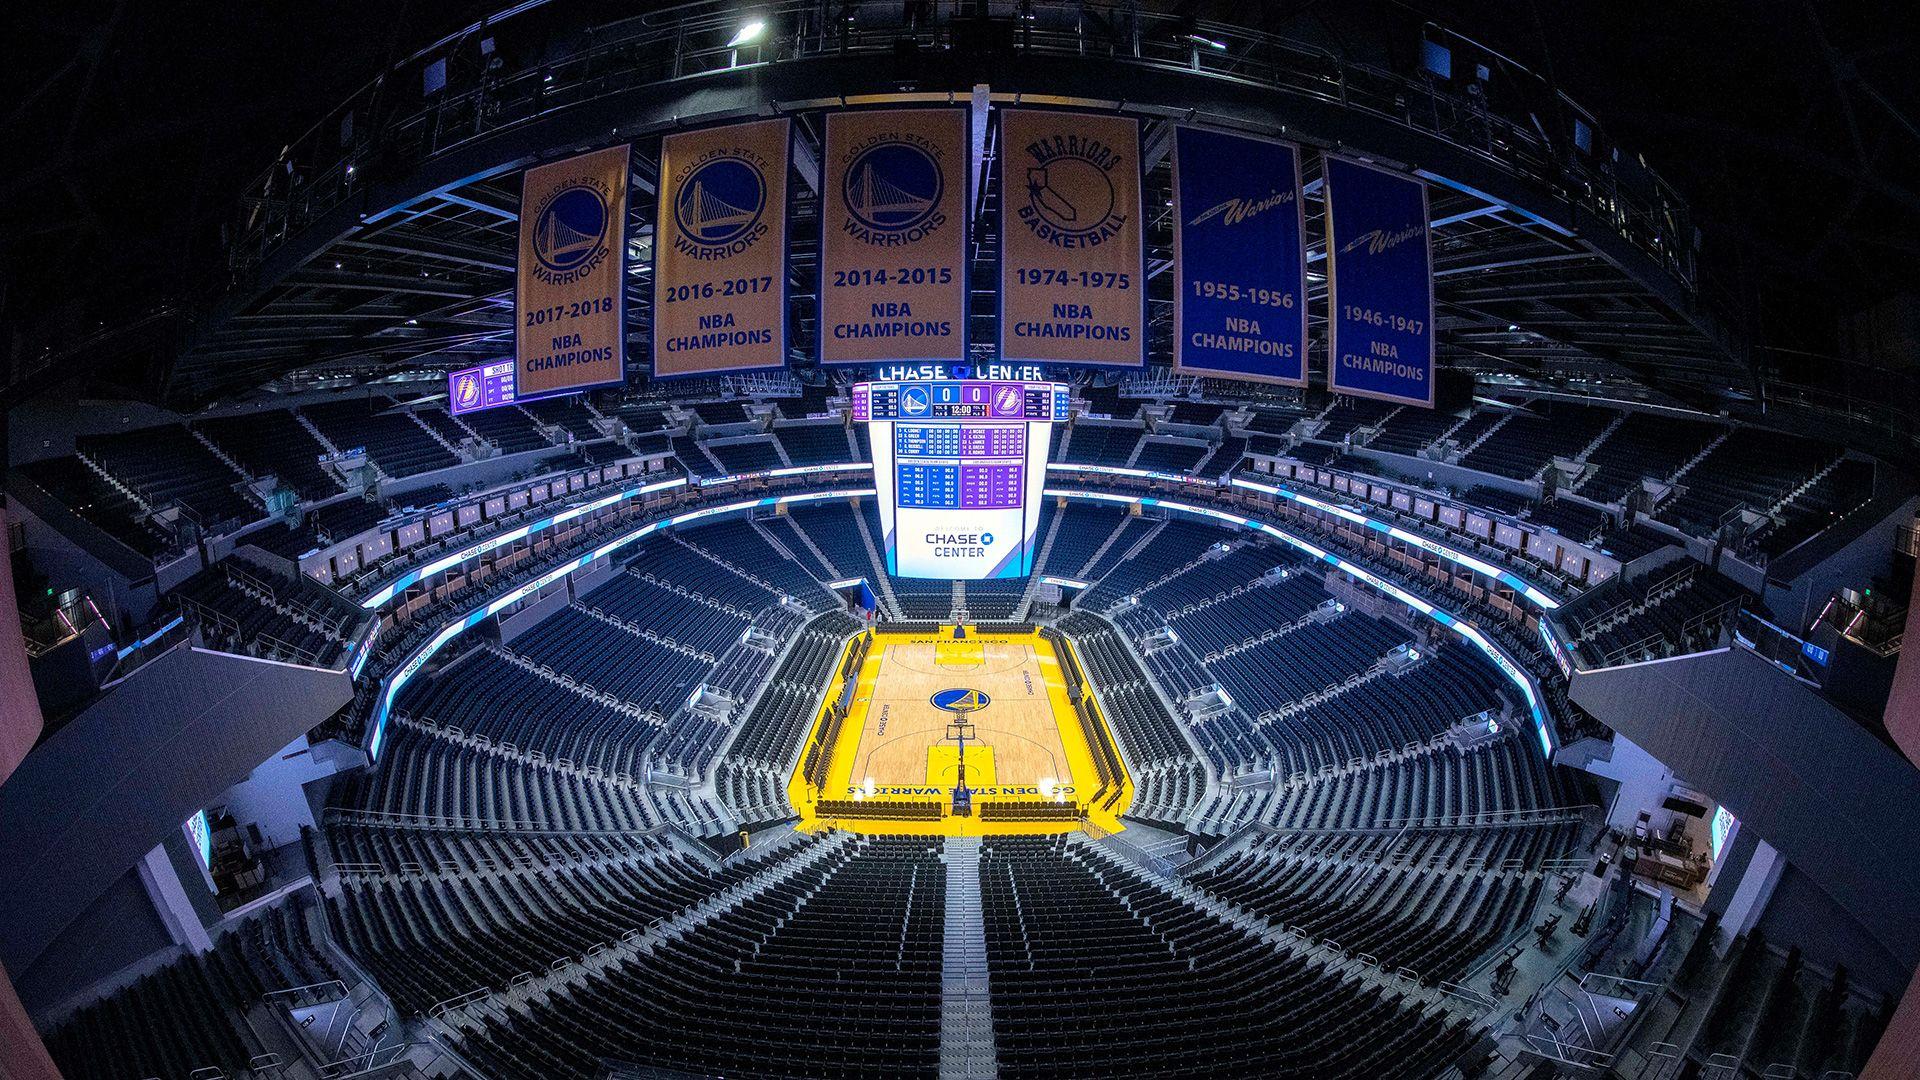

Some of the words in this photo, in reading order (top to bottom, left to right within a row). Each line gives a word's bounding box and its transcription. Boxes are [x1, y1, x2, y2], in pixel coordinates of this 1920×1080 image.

[842, 132, 899, 164] GOLDEN
[906, 133, 946, 159] STATE
[1025, 135, 1122, 172] WARRIORS
[675, 148, 728, 183] GOLDEN
[732, 148, 770, 170] STATE
[534, 177, 577, 214] GOLDEN
[581, 176, 612, 197] STATE
[1188, 189, 1294, 226] Warriors
[842, 212, 946, 247] WARRIORS
[1018, 205, 1128, 248] BASKETBALL
[674, 222, 768, 261] WARRIORS
[532, 245, 610, 286] WARRIORS
[834, 268, 952, 287] 2014-2015
[1016, 268, 1130, 290] 1974-1975
[666, 276, 772, 302] 2016-2017
[1193, 280, 1294, 309] 1955-1956
[526, 297, 612, 326] 2017-2018
[871, 302, 912, 317] NBA
[1053, 304, 1092, 319] NBA
[700, 313, 736, 330] NBA
[834, 322, 951, 338] CHAMPIONS
[1226, 317, 1260, 334] NBA
[1344, 305, 1424, 336] 1946-1947
[666, 329, 772, 352] CHAMPIONS
[1014, 322, 1130, 341] CHAMPIONS
[552, 334, 582, 350] NBA
[1192, 333, 1294, 358] CHAMPIONS
[1371, 340, 1398, 358] NBA
[526, 347, 612, 372] CHAMPIONS
[1343, 354, 1424, 381] CHAMPIONS
[880, 366, 948, 380] CHASE
[942, 388, 950, 402] 0
[972, 388, 980, 402] 0
[951, 405, 971, 413] 12:00
[926, 534, 978, 544] CHASE
[1422, 540, 1438, 551] CHASE
[461, 549, 477, 560] CHASE
[935, 547, 985, 557] CENTER
[1486, 645, 1499, 661] CHASE
[404, 662, 418, 677] CHASE
